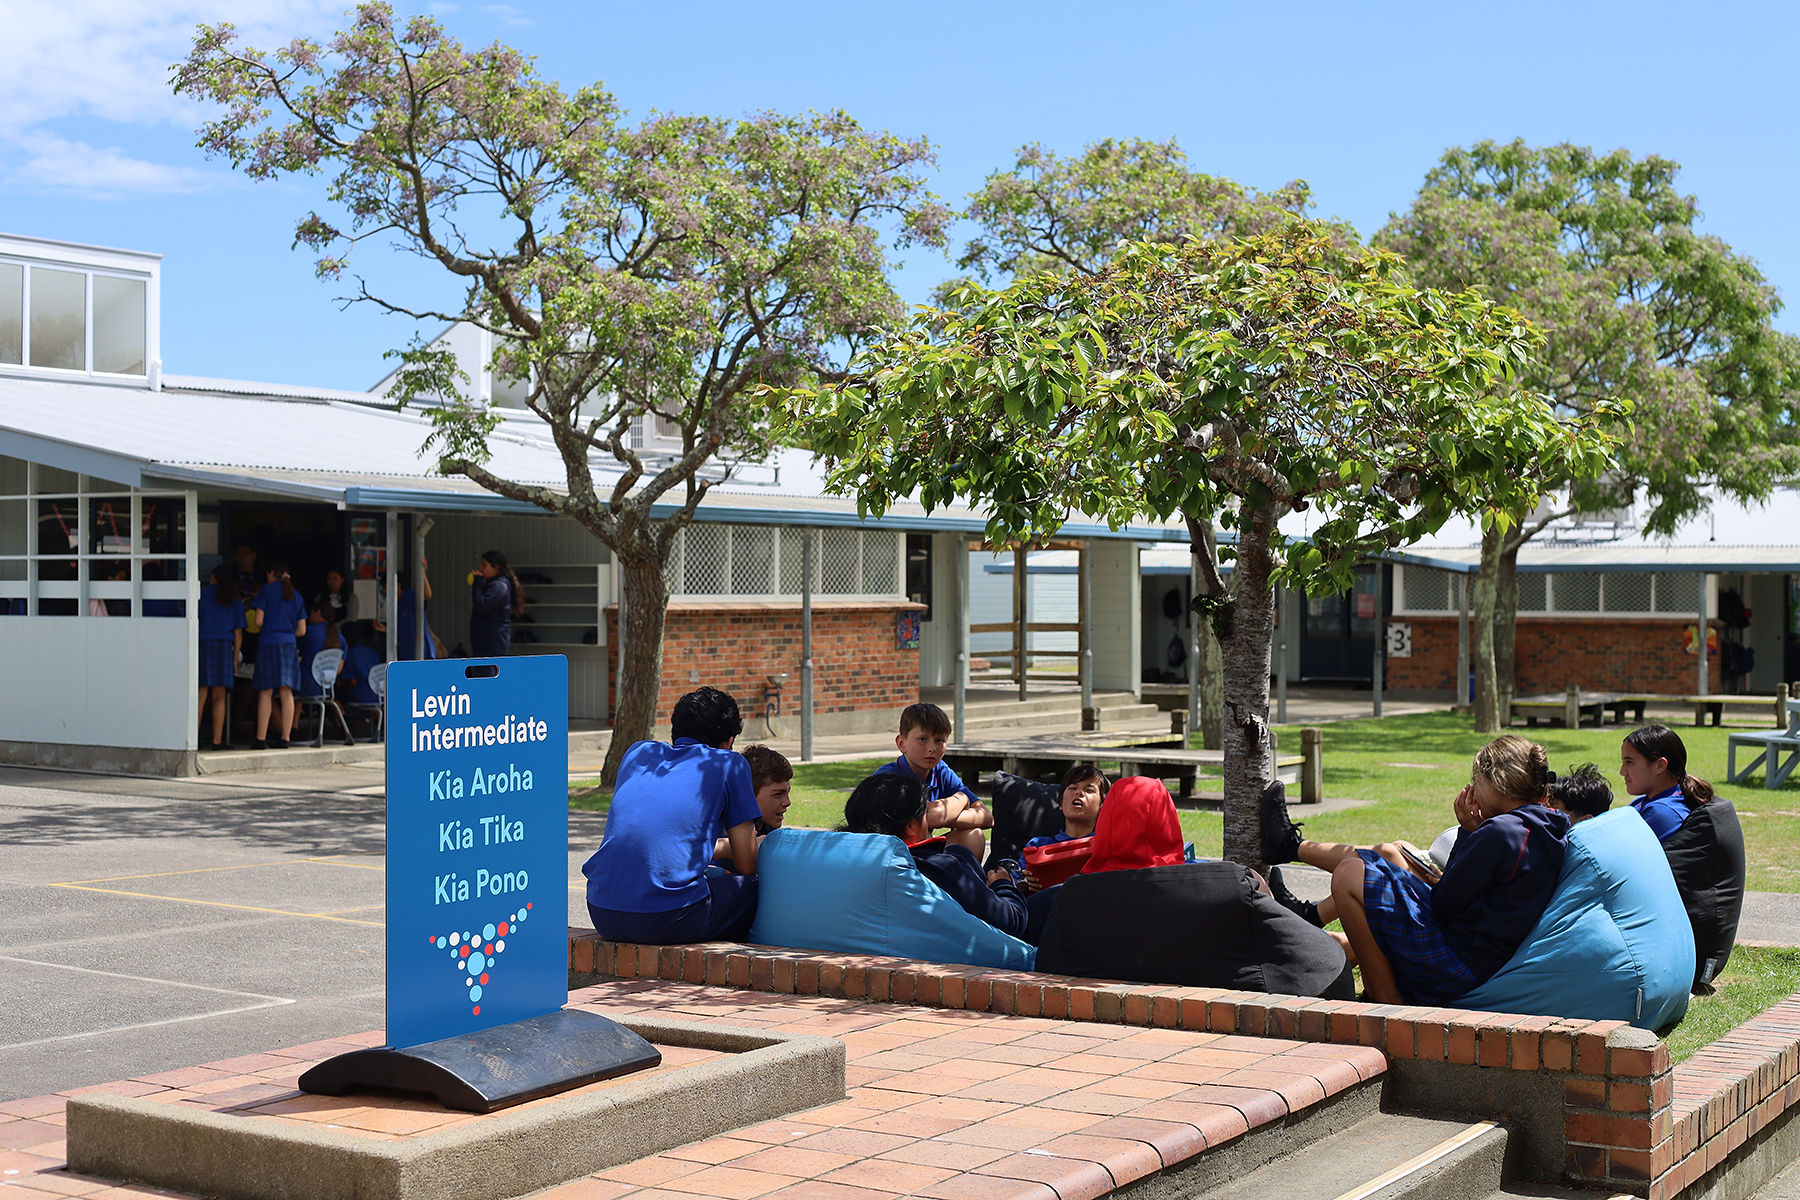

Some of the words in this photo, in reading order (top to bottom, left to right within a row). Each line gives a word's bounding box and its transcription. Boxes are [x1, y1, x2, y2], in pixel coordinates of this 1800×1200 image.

[1393, 629, 1406, 652] 3
[411, 685, 471, 719] Levin
[411, 714, 548, 753] Intermediate
[429, 769, 464, 801] Kia
[470, 763, 533, 797] Aroha
[439, 820, 474, 852] Kia
[480, 814, 525, 847] Tika
[435, 873, 470, 905] Kia
[477, 868, 529, 898] Pono
